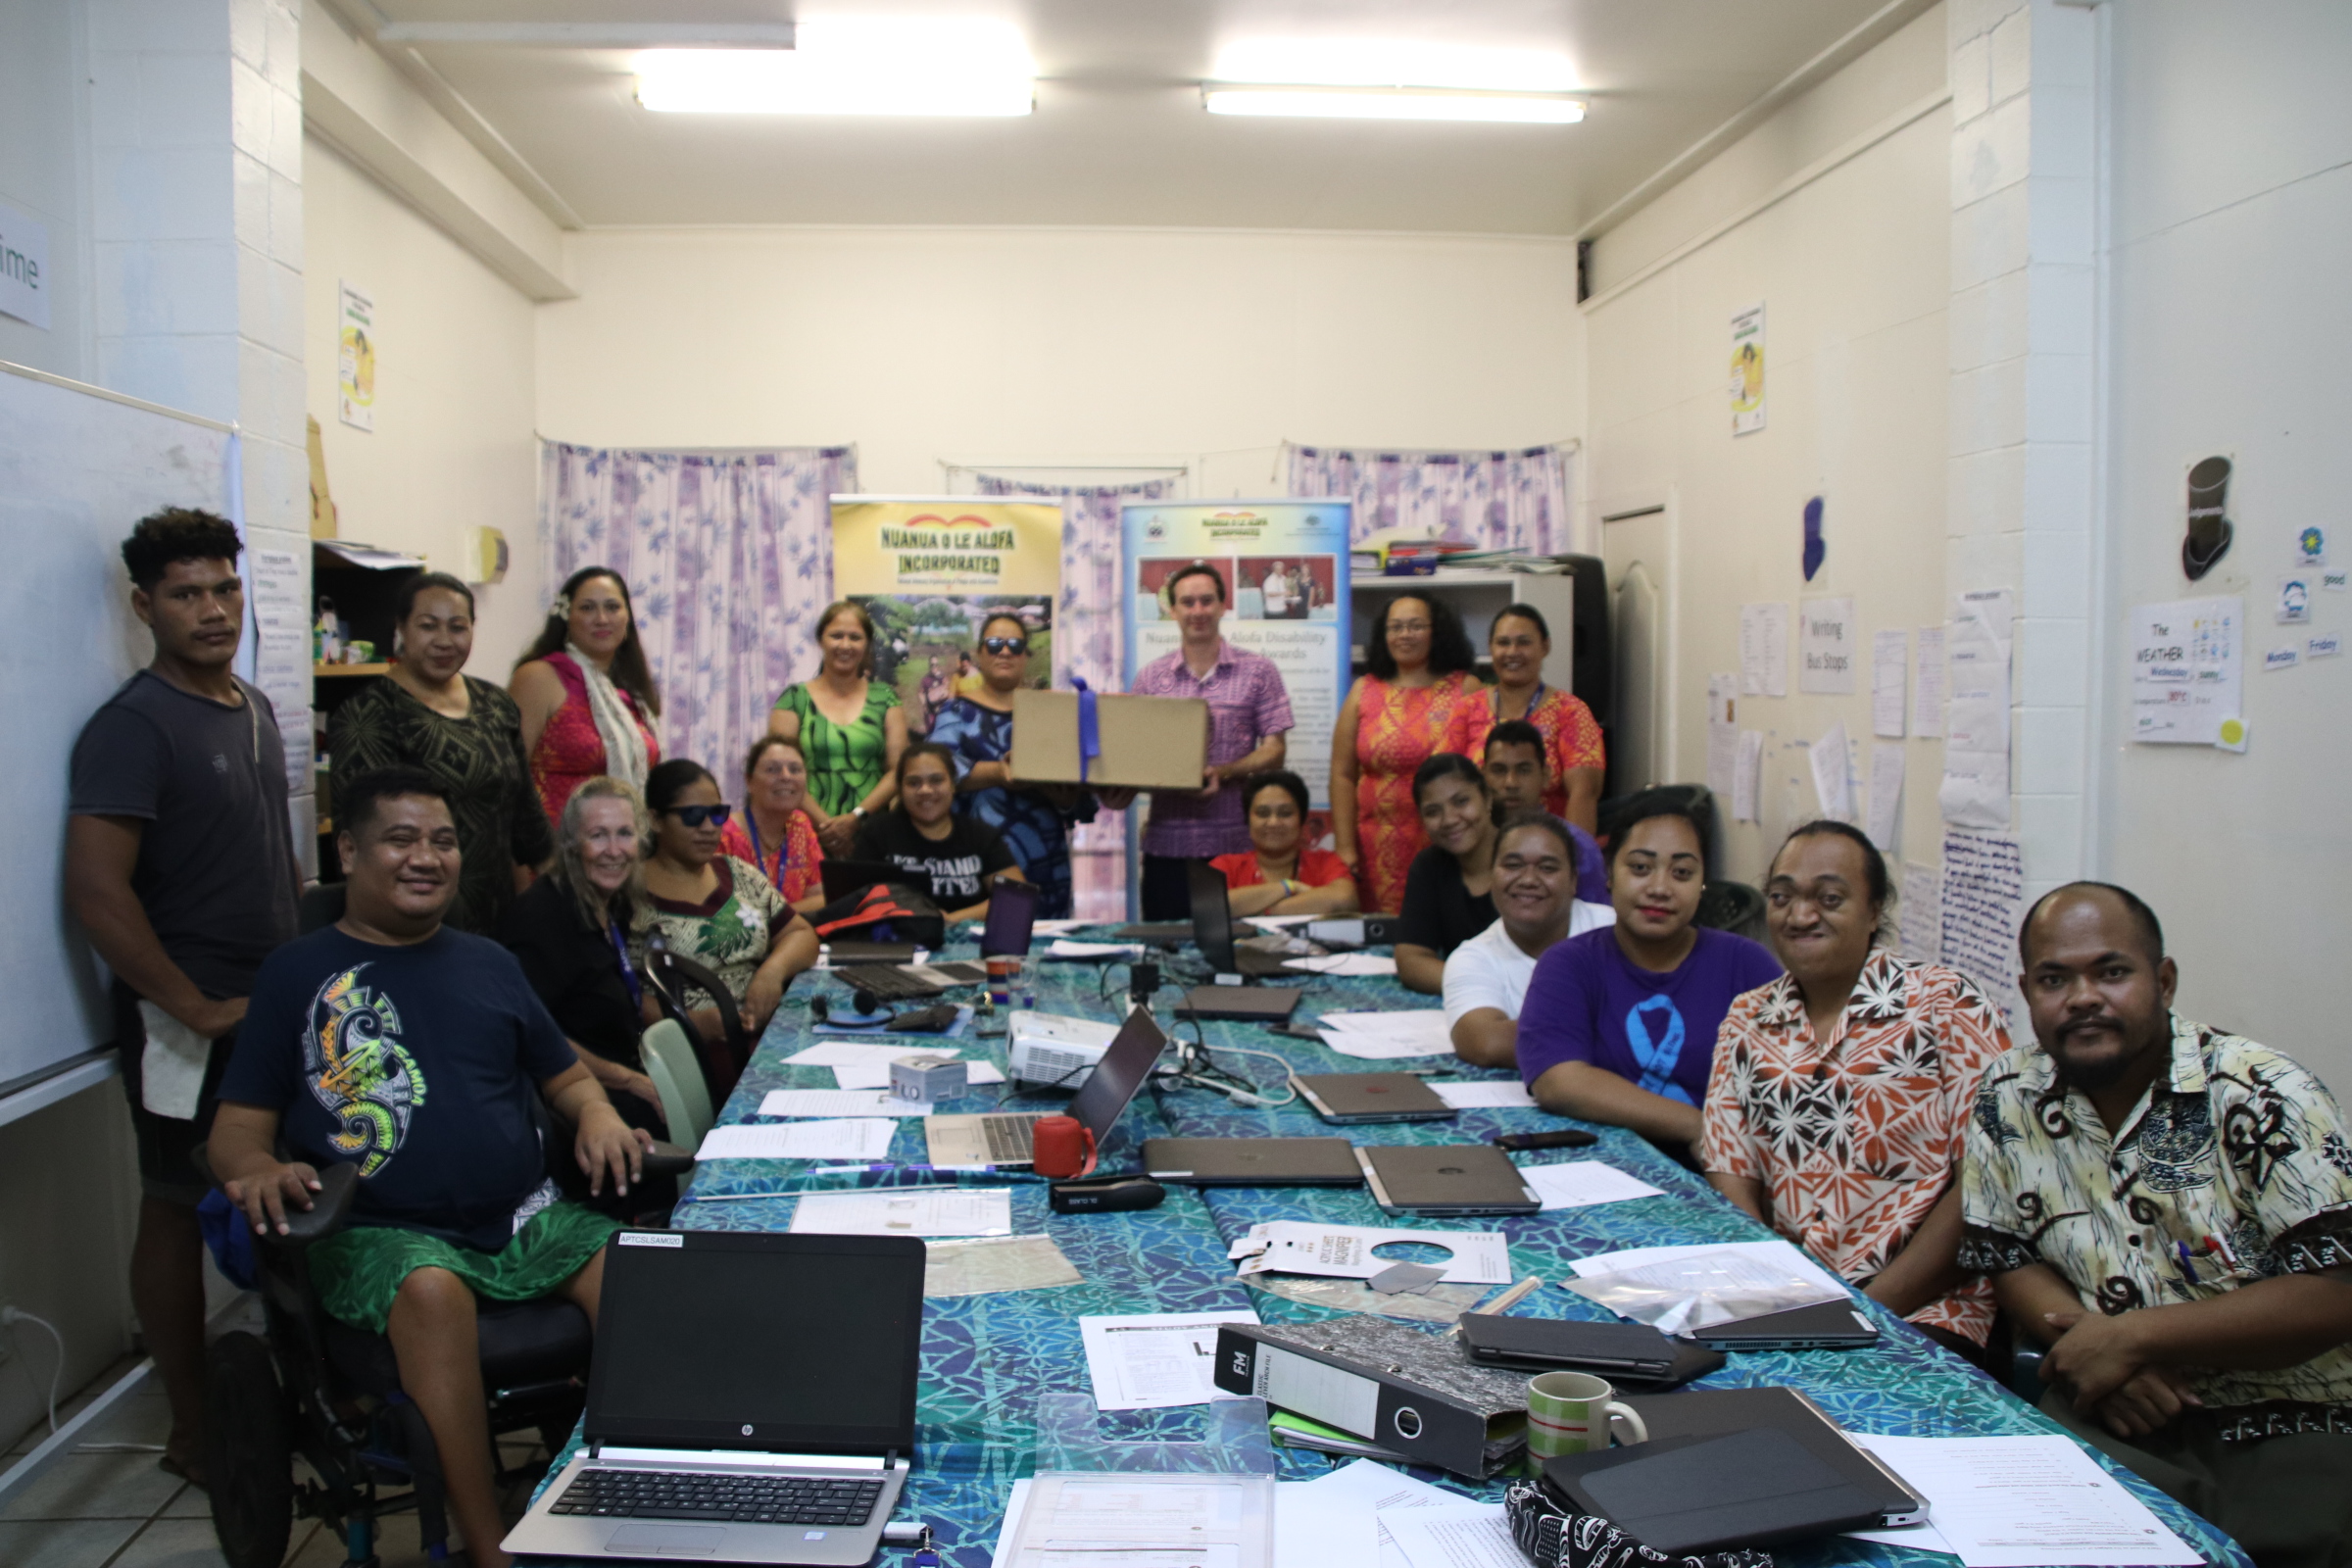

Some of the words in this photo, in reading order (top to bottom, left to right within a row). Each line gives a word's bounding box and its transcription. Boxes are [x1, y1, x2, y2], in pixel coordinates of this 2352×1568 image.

[881, 527, 938, 549] NUANUA
[941, 531, 951, 549] O
[955, 532, 970, 550] LE
[973, 528, 1015, 550] ALOFA
[898, 555, 1001, 574] INCORPORATED
[2324, 574, 2346, 586] good
[1811, 620, 1843, 640] Writing
[2152, 623, 2170, 636] The
[1230, 630, 1263, 643] Alofa
[1265, 630, 1327, 646] Disability
[2309, 639, 2337, 653] Friday
[2137, 647, 2183, 662] WEATHER
[2267, 651, 2297, 663] Monday
[1807, 654, 1822, 669] Bus
[1823, 654, 1848, 672] Stops
[2151, 666, 2188, 679] Wednesday
[2199, 670, 2220, 681] sunny
[924, 855, 982, 876] STAND
[392, 1044, 428, 1106] SAMOA
[620, 1236, 681, 1245] APTCSLSAM020
[1333, 1236, 1351, 1265] MAGNIFIER
[1233, 1351, 1248, 1376] FM
[742, 1424, 753, 1436] hp
